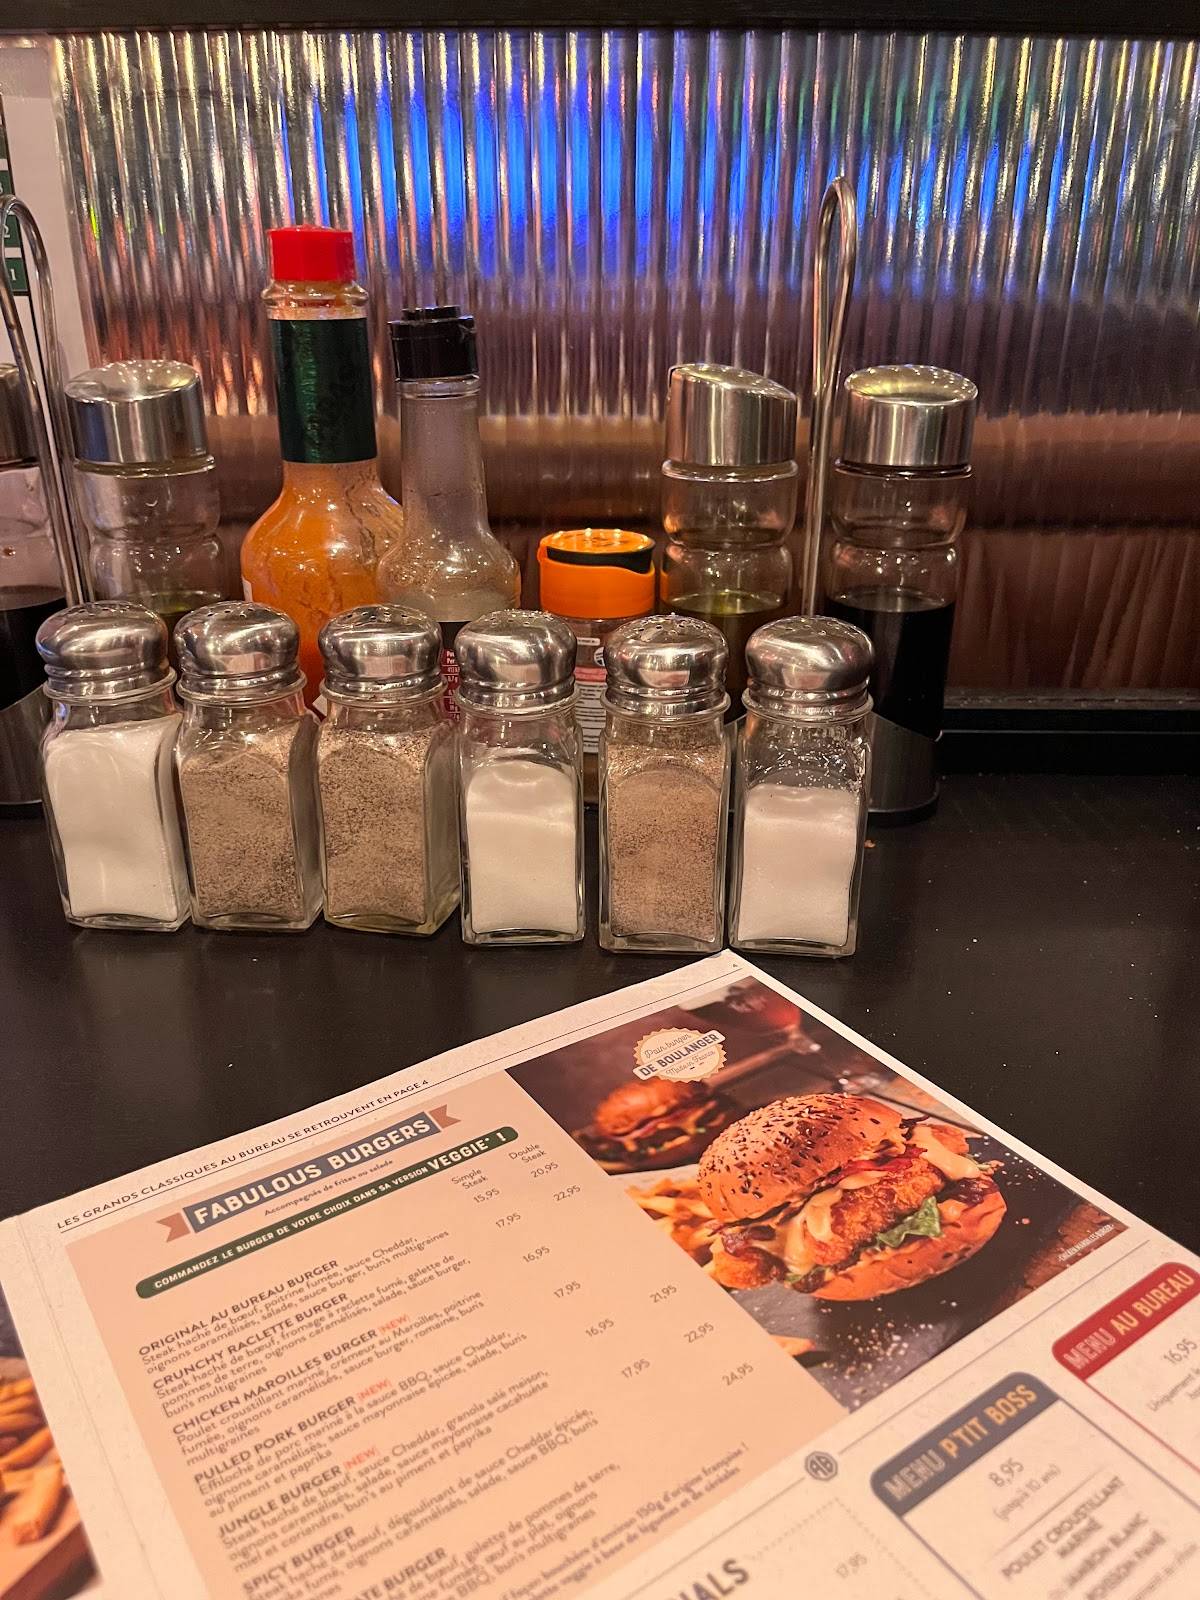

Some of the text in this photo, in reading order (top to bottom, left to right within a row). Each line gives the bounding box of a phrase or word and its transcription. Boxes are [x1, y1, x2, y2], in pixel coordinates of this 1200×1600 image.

[10, 268, 17, 281] 1
[640, 1034, 718, 1075] DE BOULANGER
[57, 1215, 79, 1228] LES
[83, 1193, 138, 1217] GRANDS
[141, 1162, 217, 1195] CLASSIQUES
[219, 1155, 236, 1165] AU
[239, 1137, 285, 1157] BUREAU
[288, 1131, 301, 1139] SE
[303, 1102, 375, 1132] RETROUVENT
[377, 1095, 392, 1103] EN
[393, 1084, 420, 1096] PAGE
[509, 1145, 539, 1158] Double
[521, 1149, 546, 1162] Steak
[531, 1162, 559, 1177] 20,95
[194, 1119, 433, 1224] FABULOUS BURGERS
[263, 1191, 321, 1215] Accompagnés
[334, 1176, 356, 1186] frites
[370, 1161, 393, 1171] salade
[451, 1170, 481, 1183] Simple
[462, 1175, 488, 1189] Steak
[473, 1188, 500, 1203] 15,95
[553, 1185, 582, 1201] 22,95
[154, 1256, 219, 1288] COMMANDEZ
[221, 1249, 234, 1259] LE
[236, 1233, 274, 1252] BURGER
[276, 1226, 289, 1235] DE
[292, 1212, 321, 1228] VOTRE
[323, 1200, 352, 1214] CHOIX
[353, 1189, 377, 1202] DANS
[378, 1183, 391, 1191] SA
[392, 1167, 428, 1185] VERSION
[496, 1213, 521, 1227] 17,95
[522, 1246, 550, 1263] 16,95
[139, 1260, 338, 1356] ORIGINAL AU BUREAU BURGER
[142, 1239, 417, 1364] Steak haché de bœuf, poitrine fumée, sauce Cheddar,
[147, 1232, 449, 1373] oignons caramélisés, salade, sauce burger, multigraines
[553, 1281, 582, 1299] 17,95
[649, 1284, 678, 1303] 21,95
[157, 1378, 190, 1399] Steak
[192, 1361, 226, 1382] haché
[228, 1355, 244, 1364] de
[246, 1338, 280, 1356] bœuf,
[281, 1317, 325, 1339] fromage
[337, 1294, 374, 1313] raclette
[376, 1279, 407, 1294] fumé,
[408, 1262, 441, 1282] galette
[440, 1255, 455, 1263] de
[162, 1382, 211, 1411] pommes
[213, 1373, 228, 1383] de
[265, 1337, 306, 1358] oignons
[309, 1308, 371, 1337] caramélisés,
[373, 1291, 406, 1307] salade,
[408, 1276, 434, 1290] sauce
[435, 1260, 470, 1276] burger,
[585, 1318, 615, 1338] 16,95
[683, 1322, 715, 1343] 22,95
[1063, 1271, 1196, 1367] MENU AU BUREAU
[153, 1293, 348, 1389] CRUNCHY RACLETTE BURGER
[1163, 1338, 1197, 1364] 16,95
[173, 1329, 377, 1436] CHICKEN MAROILLES BURGER
[198, 1366, 267, 1402] multigraines
[621, 1357, 651, 1379] 17,95
[722, 1363, 754, 1385] 24,95
[195, 1396, 356, 1485] PULLED PORK BURGER
[884, 1450, 946, 1499] MENU
[984, 1383, 1039, 1424] BOSS
[988, 1457, 1026, 1487] 8,95
[218, 1465, 341, 1538] JUNGLE BURGER
[243, 1562, 288, 1595] SPICY
[292, 1525, 355, 1568] BURGER
[383, 1547, 447, 1592] BURGER
